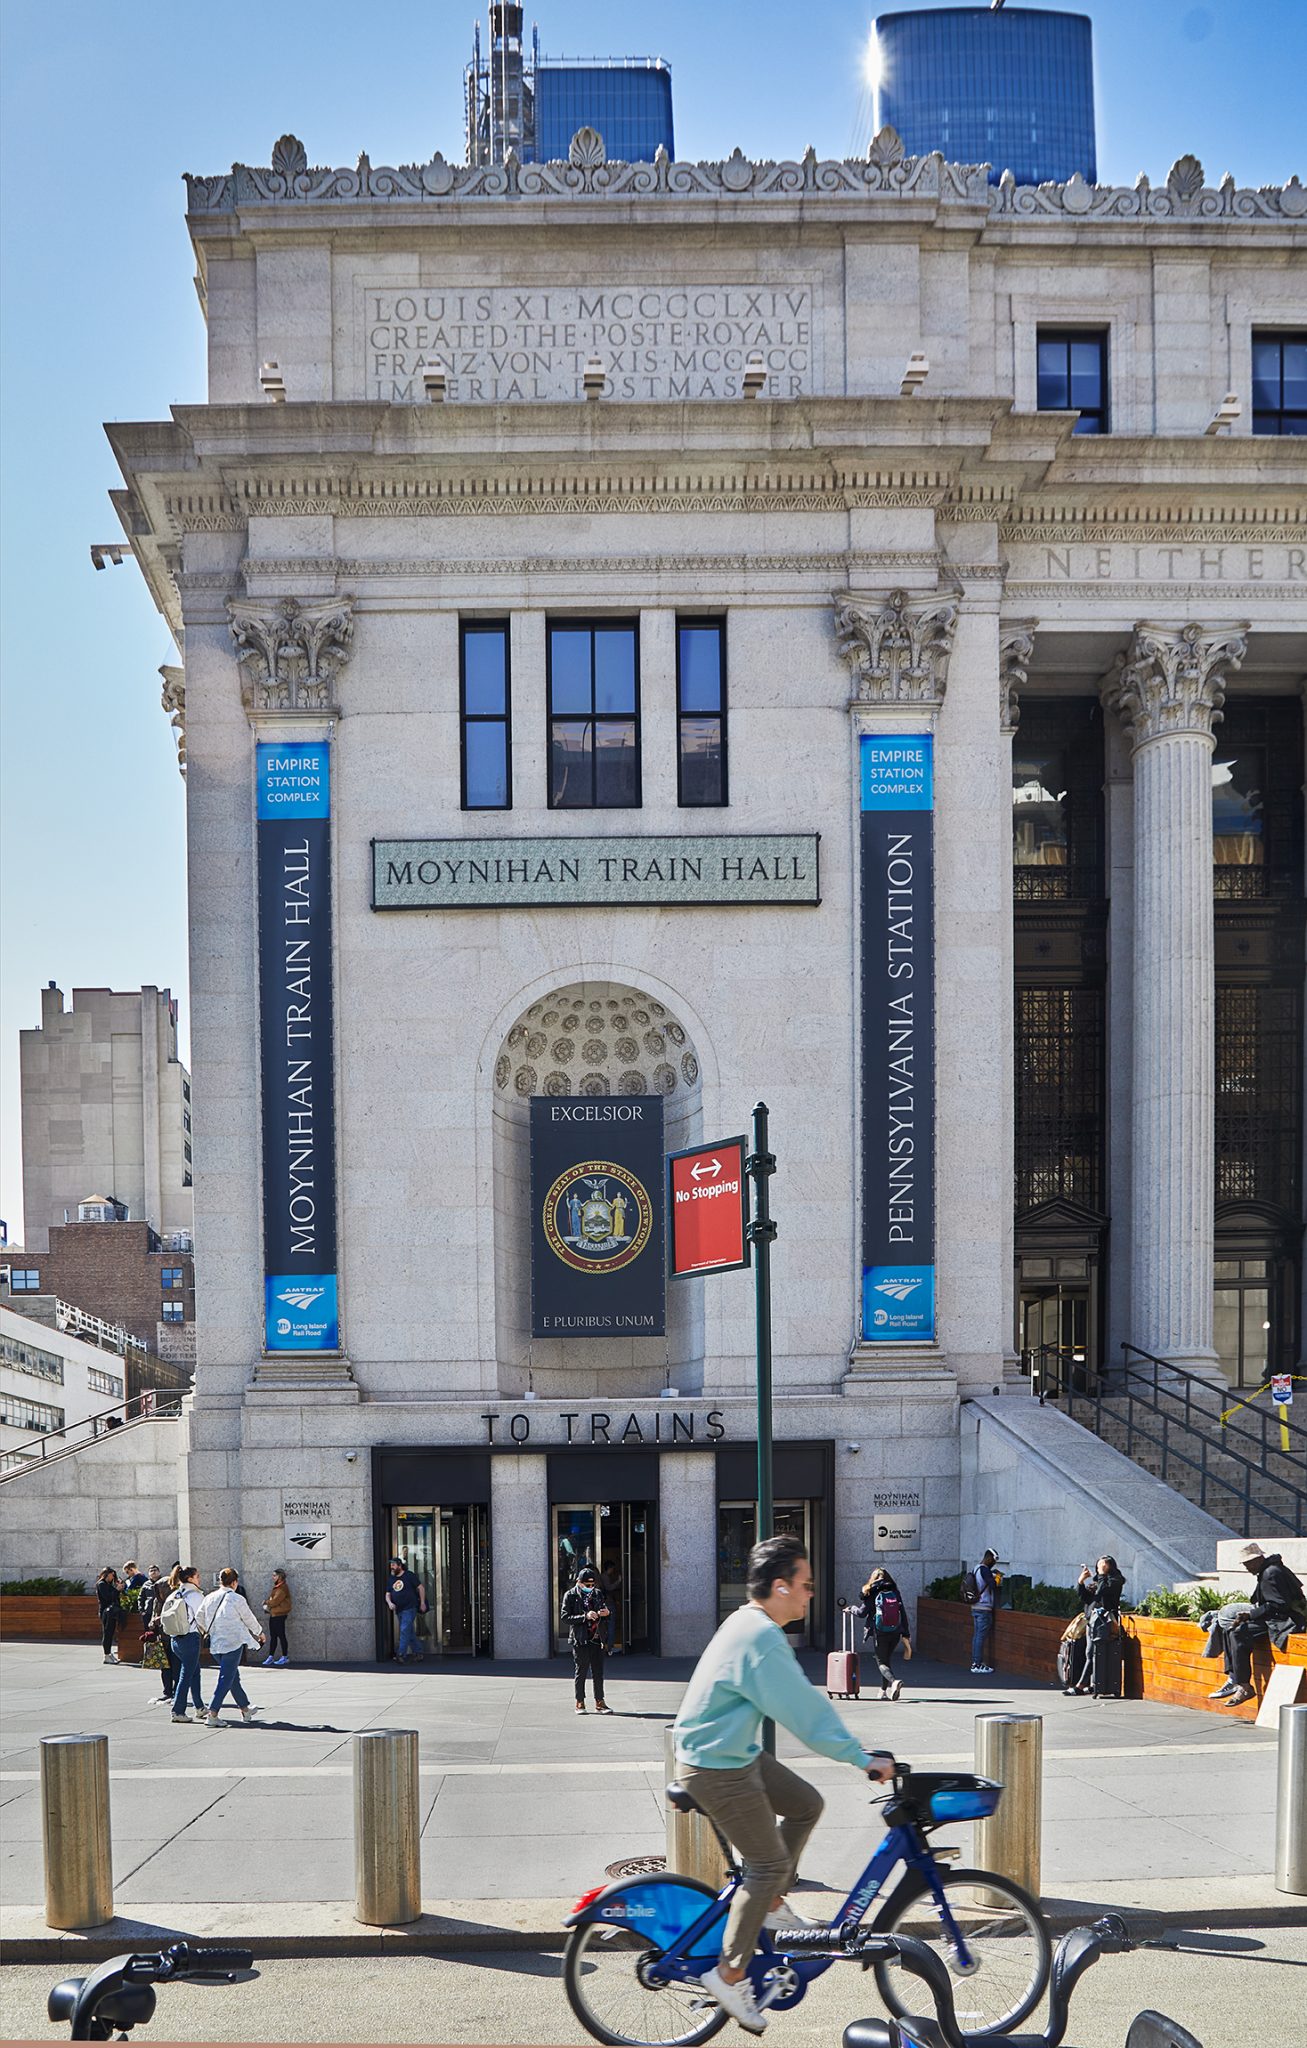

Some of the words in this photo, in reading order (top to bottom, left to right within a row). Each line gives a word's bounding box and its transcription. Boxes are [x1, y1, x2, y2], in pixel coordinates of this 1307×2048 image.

[374, 295, 492, 322] LOUIS
[515, 295, 550, 321] XI
[578, 292, 808, 320] MCCCCLXIV
[370, 325, 508, 349] CREATED
[516, 323, 576, 348] THE
[591, 322, 682, 347] POSTE
[693, 321, 809, 346] ROYALE
[487, 351, 551, 375] VON
[567, 350, 658, 373] TXIS
[375, 378, 547, 400] IMERIAL
[1044, 548, 1307, 580] NEITHER
[267, 758, 320, 771] EMPIRE
[871, 750, 923, 762] EMPIRE
[267, 776, 320, 787] STATION
[871, 768, 923, 778] STATION
[267, 792, 320, 802] COMPLEX
[871, 784, 923, 794] COMPLEX
[386, 858, 581, 885] MOYNIHAN
[599, 857, 702, 883] TRAIN
[721, 856, 806, 881] HALL
[284, 838, 311, 925] HALL
[887, 833, 914, 979] STATION
[286, 940, 312, 1047] TRAIN
[551, 1106, 644, 1121] EXCELSIOR
[888, 992, 914, 1243] PENNSYLVANIA
[288, 1060, 316, 1254] MOYNIHAN
[572, 1167, 585, 1176] OF
[610, 1167, 637, 1188] STATE
[552, 1176, 571, 1196] SEAL
[637, 1189, 646, 1201] OF
[676, 1190, 690, 1203] No
[692, 1181, 738, 1200] Stopping
[551, 1236, 566, 1254] THE
[543, 1316, 550, 1328] E
[554, 1316, 612, 1328] PLURIBUS
[616, 1315, 654, 1327] UNUM
[481, 1413, 530, 1443] TO
[560, 1411, 725, 1442] TRAINS
